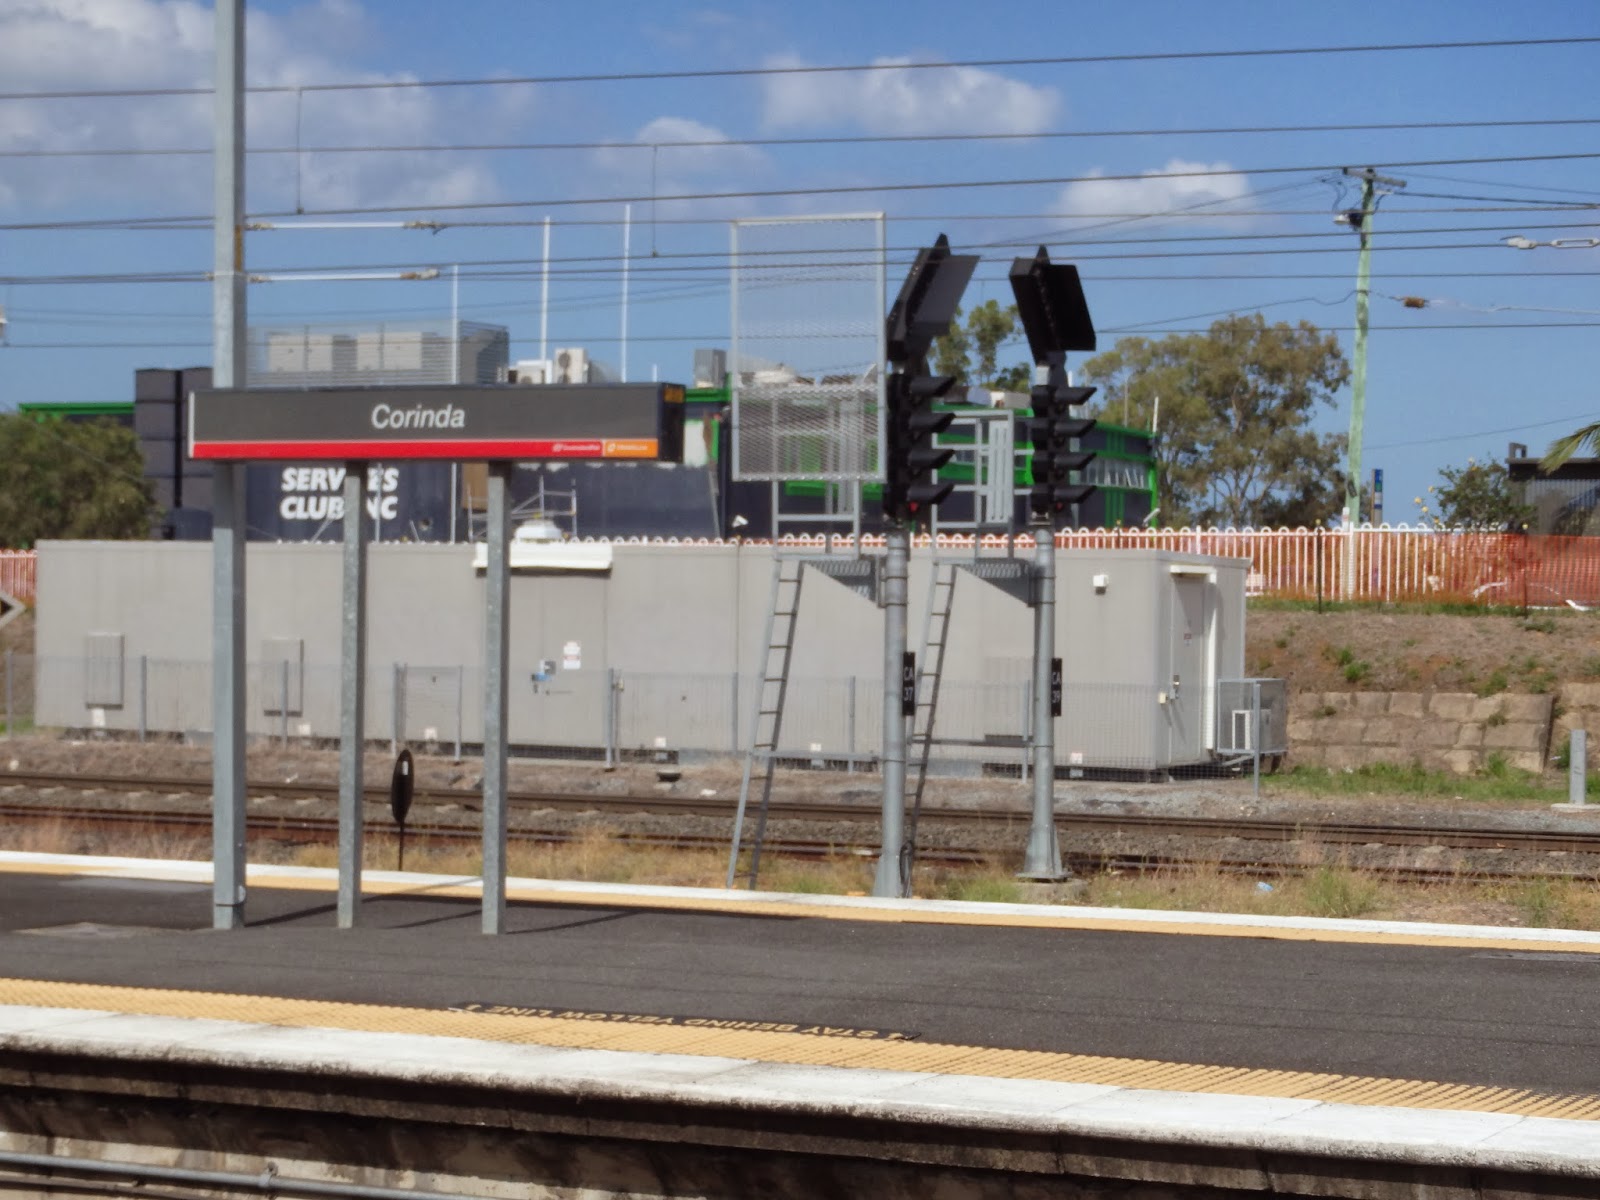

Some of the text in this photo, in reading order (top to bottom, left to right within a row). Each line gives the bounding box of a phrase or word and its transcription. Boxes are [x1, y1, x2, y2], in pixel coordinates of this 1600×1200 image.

[371, 403, 466, 430] Corinda
[280, 466, 400, 493] SERVES
[279, 495, 346, 521] CLUB
[485, 1005, 879, 1038] STAY BEHIND YELLOW LINE
